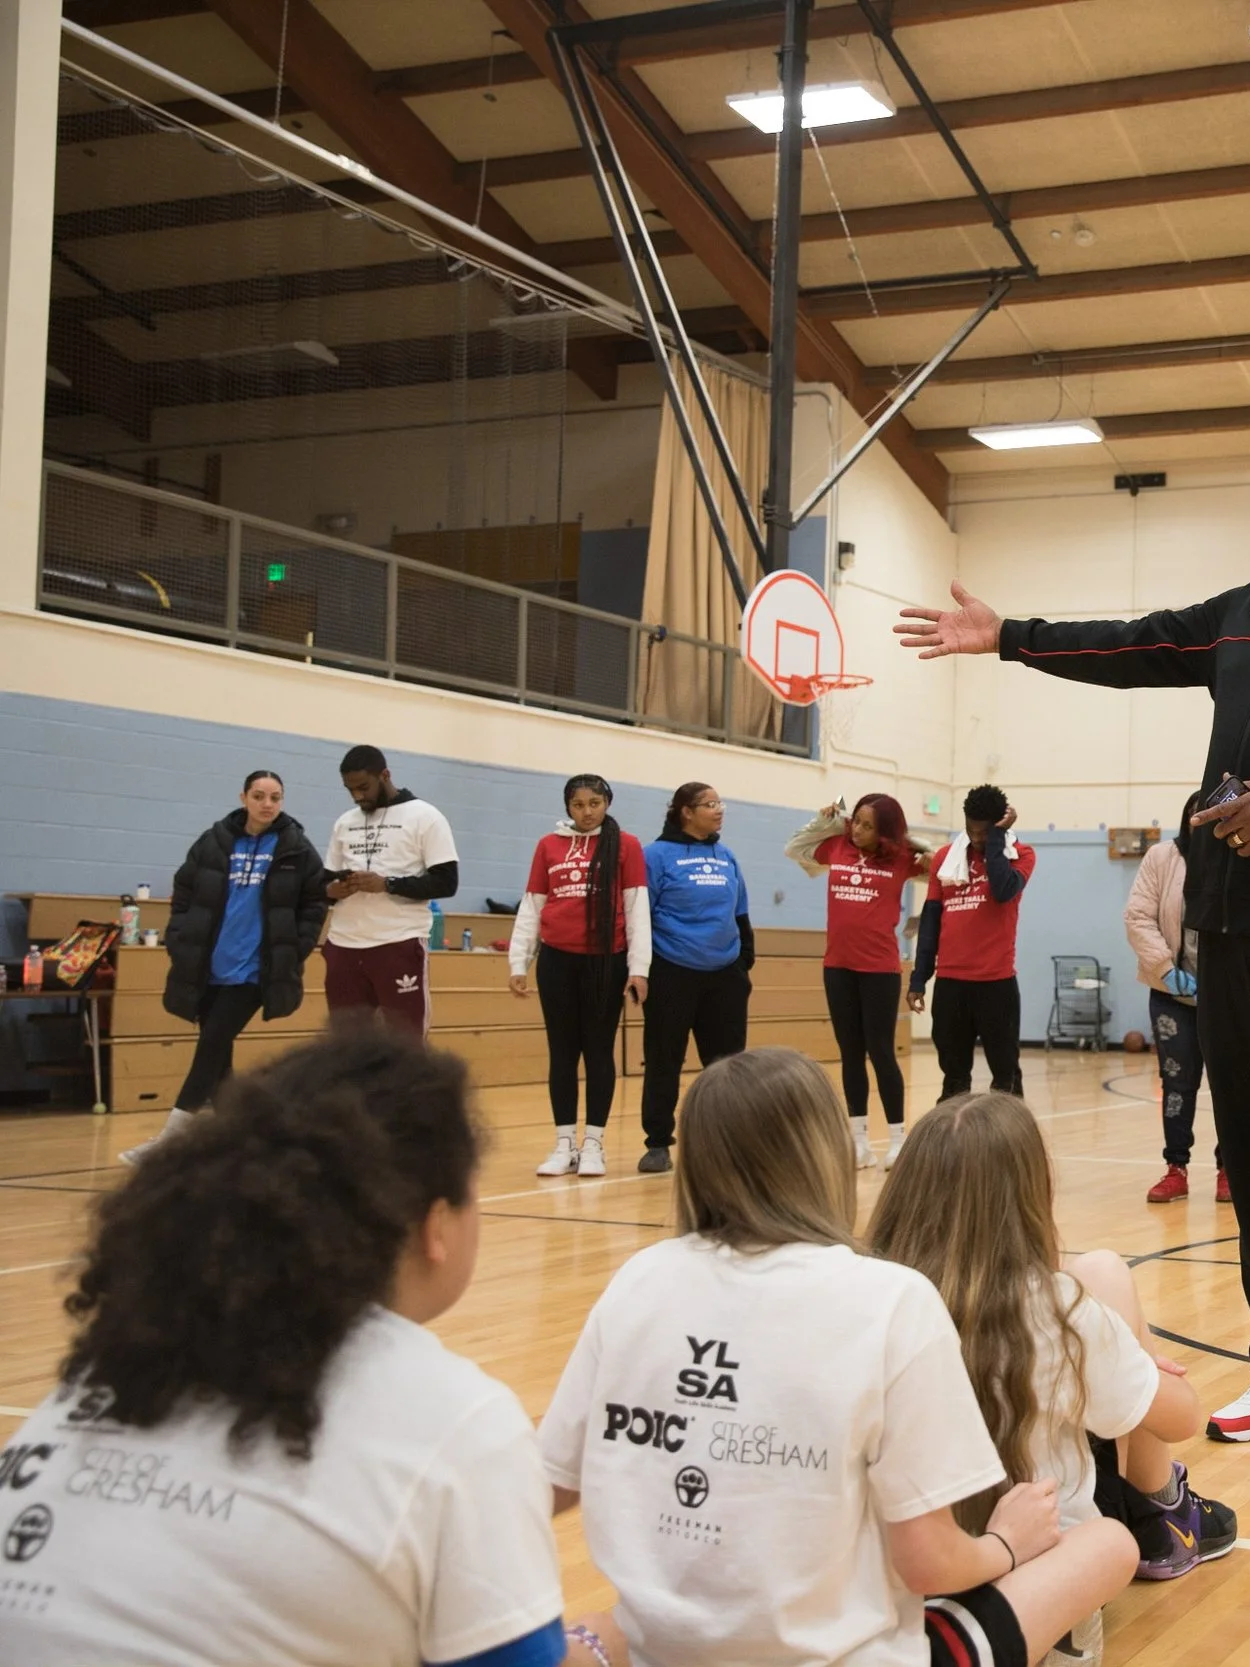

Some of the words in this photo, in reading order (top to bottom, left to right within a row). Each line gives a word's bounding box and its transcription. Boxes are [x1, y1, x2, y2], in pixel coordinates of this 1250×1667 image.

[830, 884, 880, 898] BASKETBALL
[834, 892, 873, 903] ACADEMY
[602, 1402, 688, 1454] POIC
[711, 1420, 752, 1439] CITY
[752, 1424, 779, 1443] OF
[84, 1448, 135, 1471] CITY
[136, 1453, 173, 1474] OF
[708, 1436, 829, 1472] GRESHAM
[65, 1467, 237, 1523] GRESHAM
